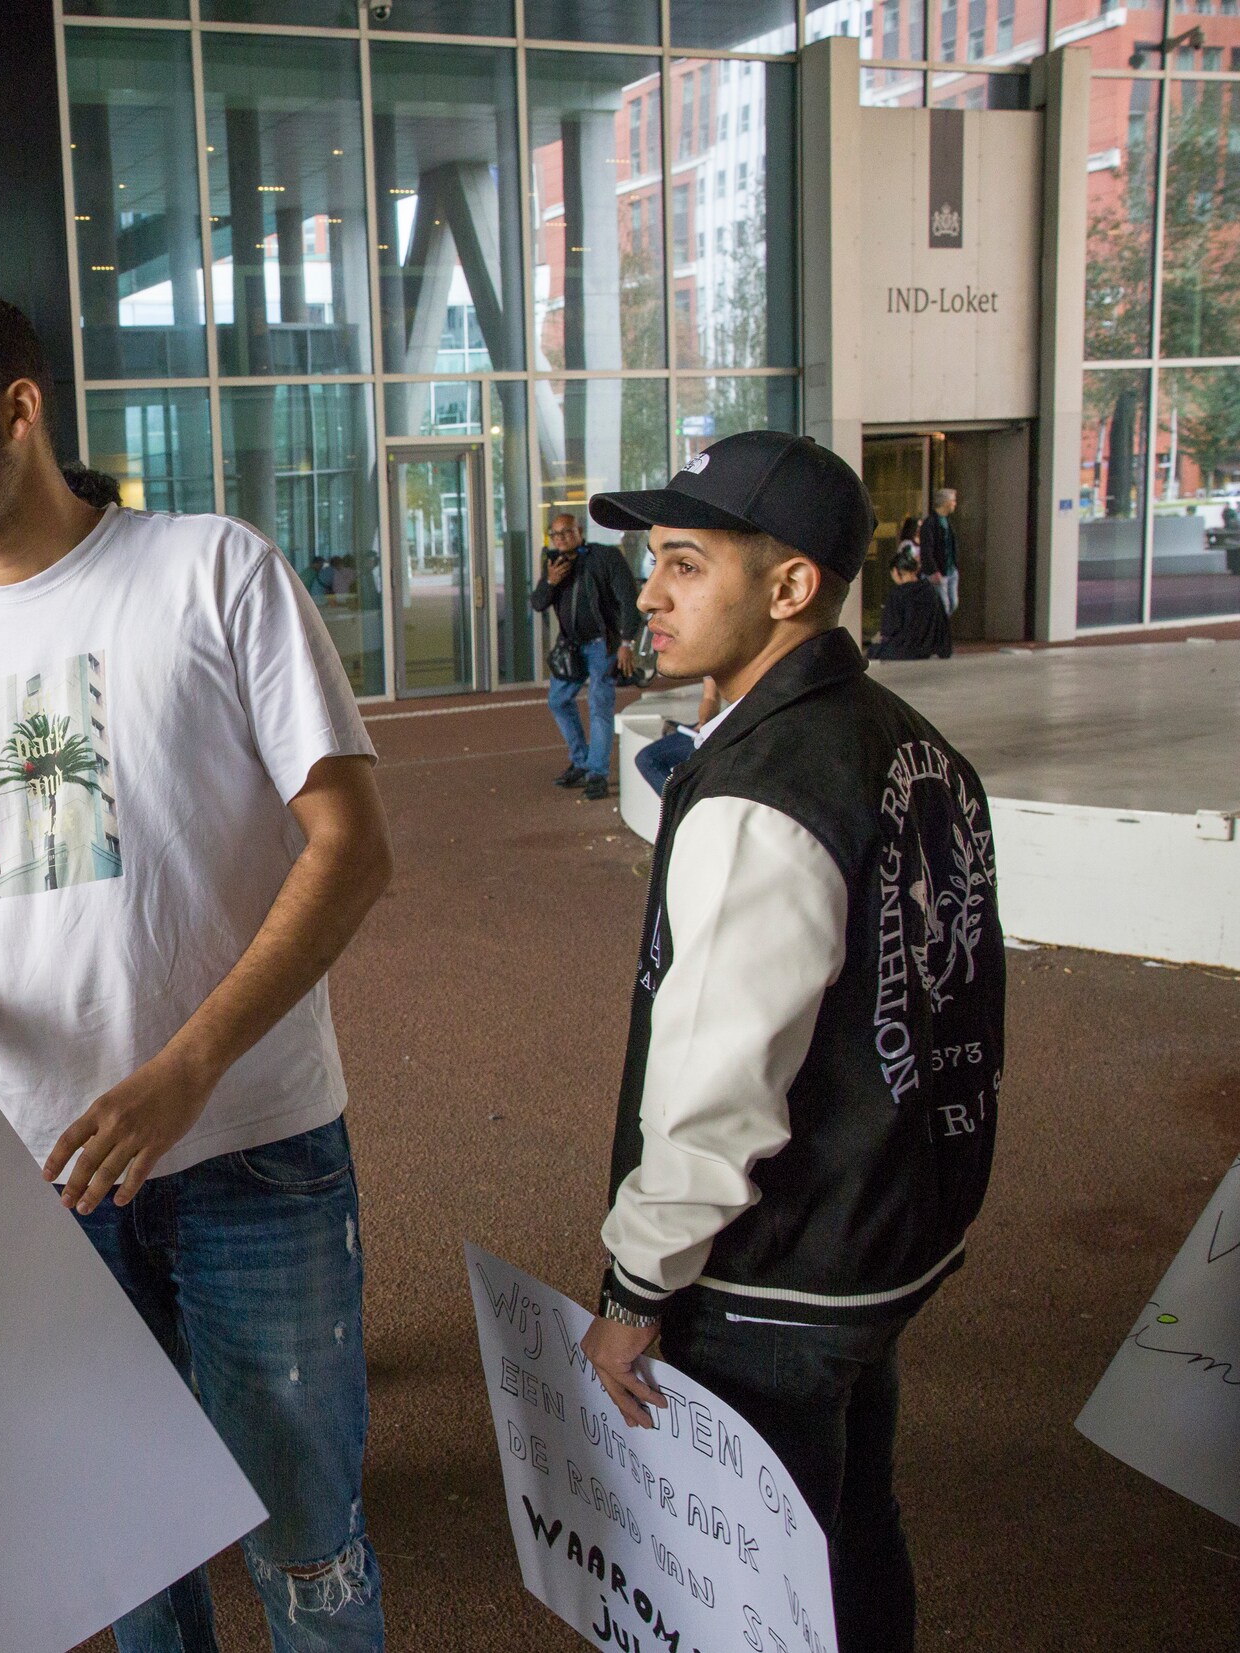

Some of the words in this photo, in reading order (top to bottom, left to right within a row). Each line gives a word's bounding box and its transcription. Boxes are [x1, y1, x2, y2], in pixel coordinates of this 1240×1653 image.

[887, 285, 998, 313] IND-Loket
[873, 841, 920, 1104] NOTHING
[500, 1355, 565, 1422] EEN
[507, 1420, 550, 1476] DE
[566, 1460, 642, 1544] RAAD
[650, 1534, 715, 1609] VAN
[521, 1494, 680, 1653] WAAROM
